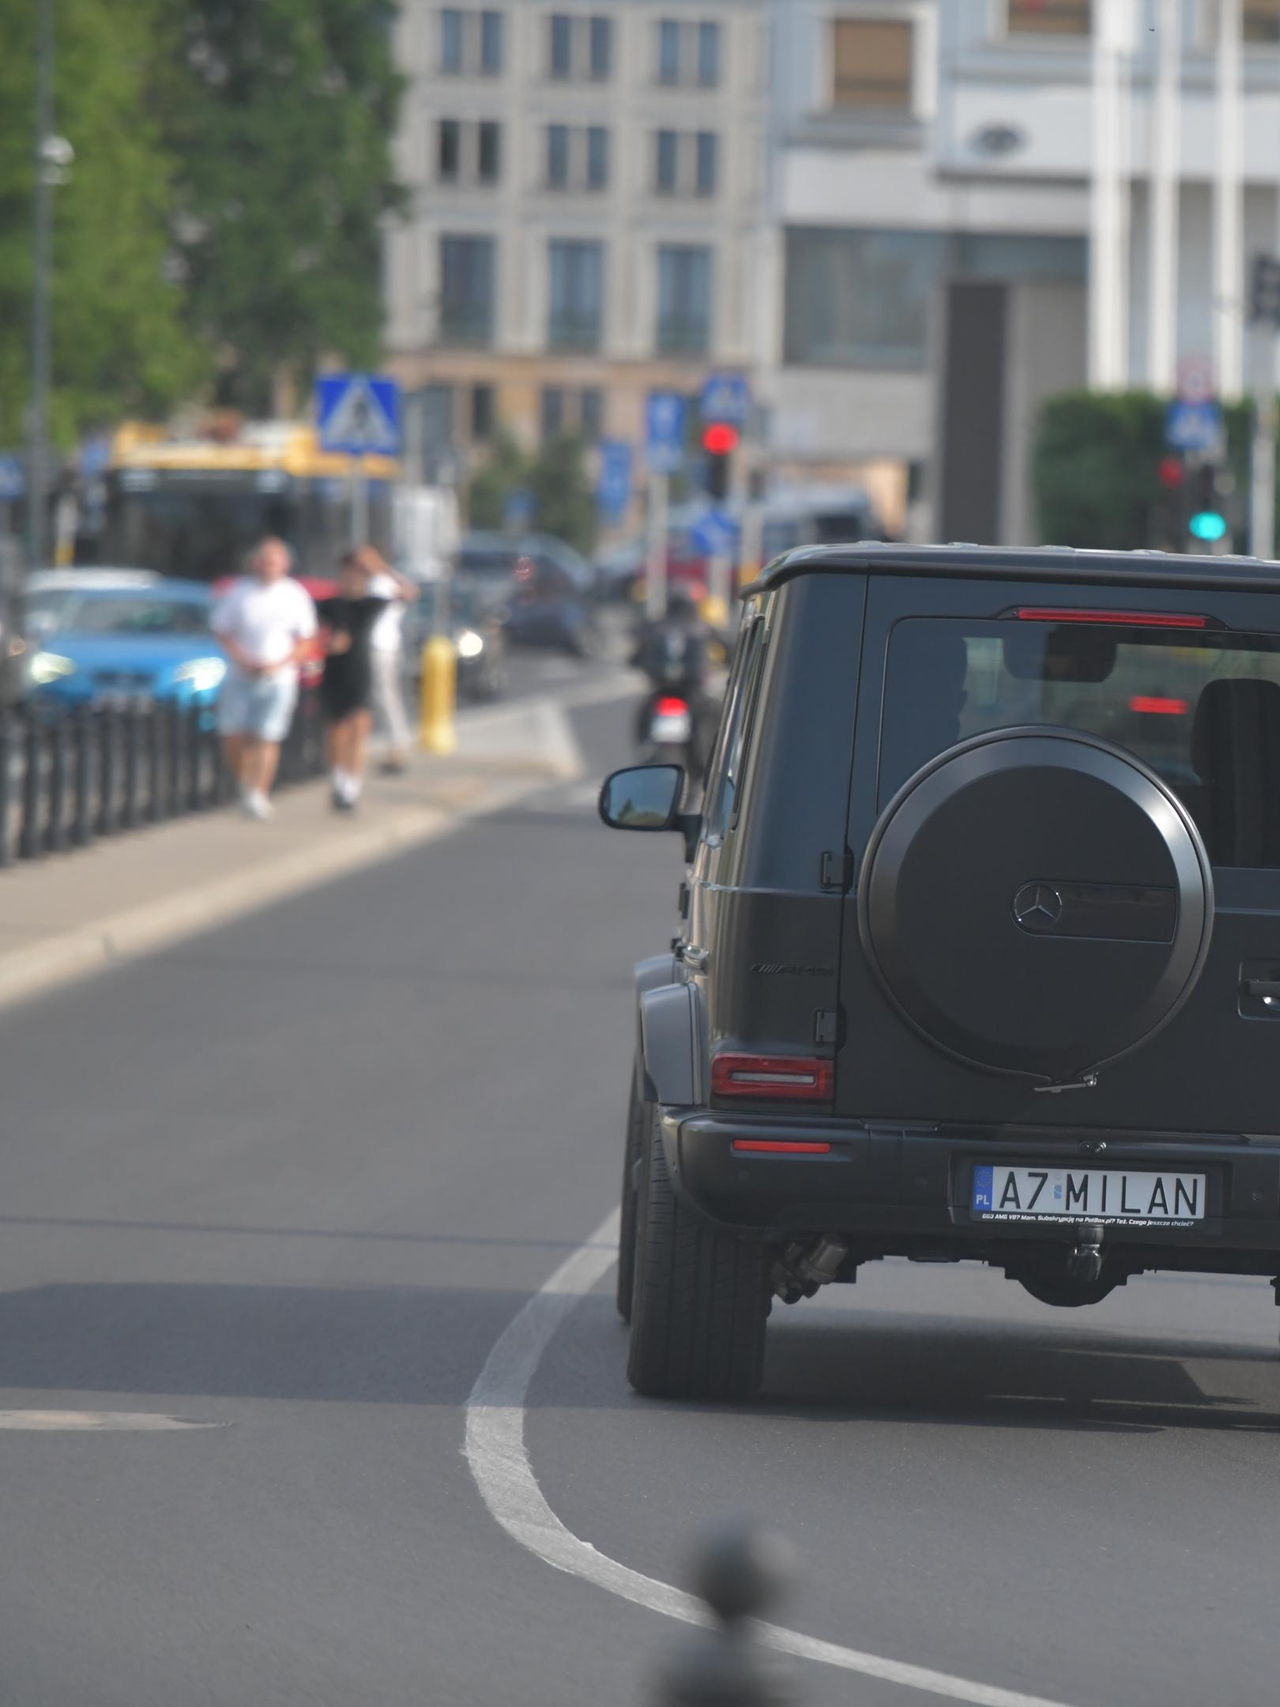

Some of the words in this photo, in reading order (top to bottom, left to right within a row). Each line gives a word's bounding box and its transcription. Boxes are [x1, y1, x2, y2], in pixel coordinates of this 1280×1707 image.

[999, 1171, 1048, 1209] A7
[1065, 1173, 1198, 1215] MILAN
[976, 1194, 989, 1204] PL
[1037, 1215, 1074, 1223] Subskrypcję
